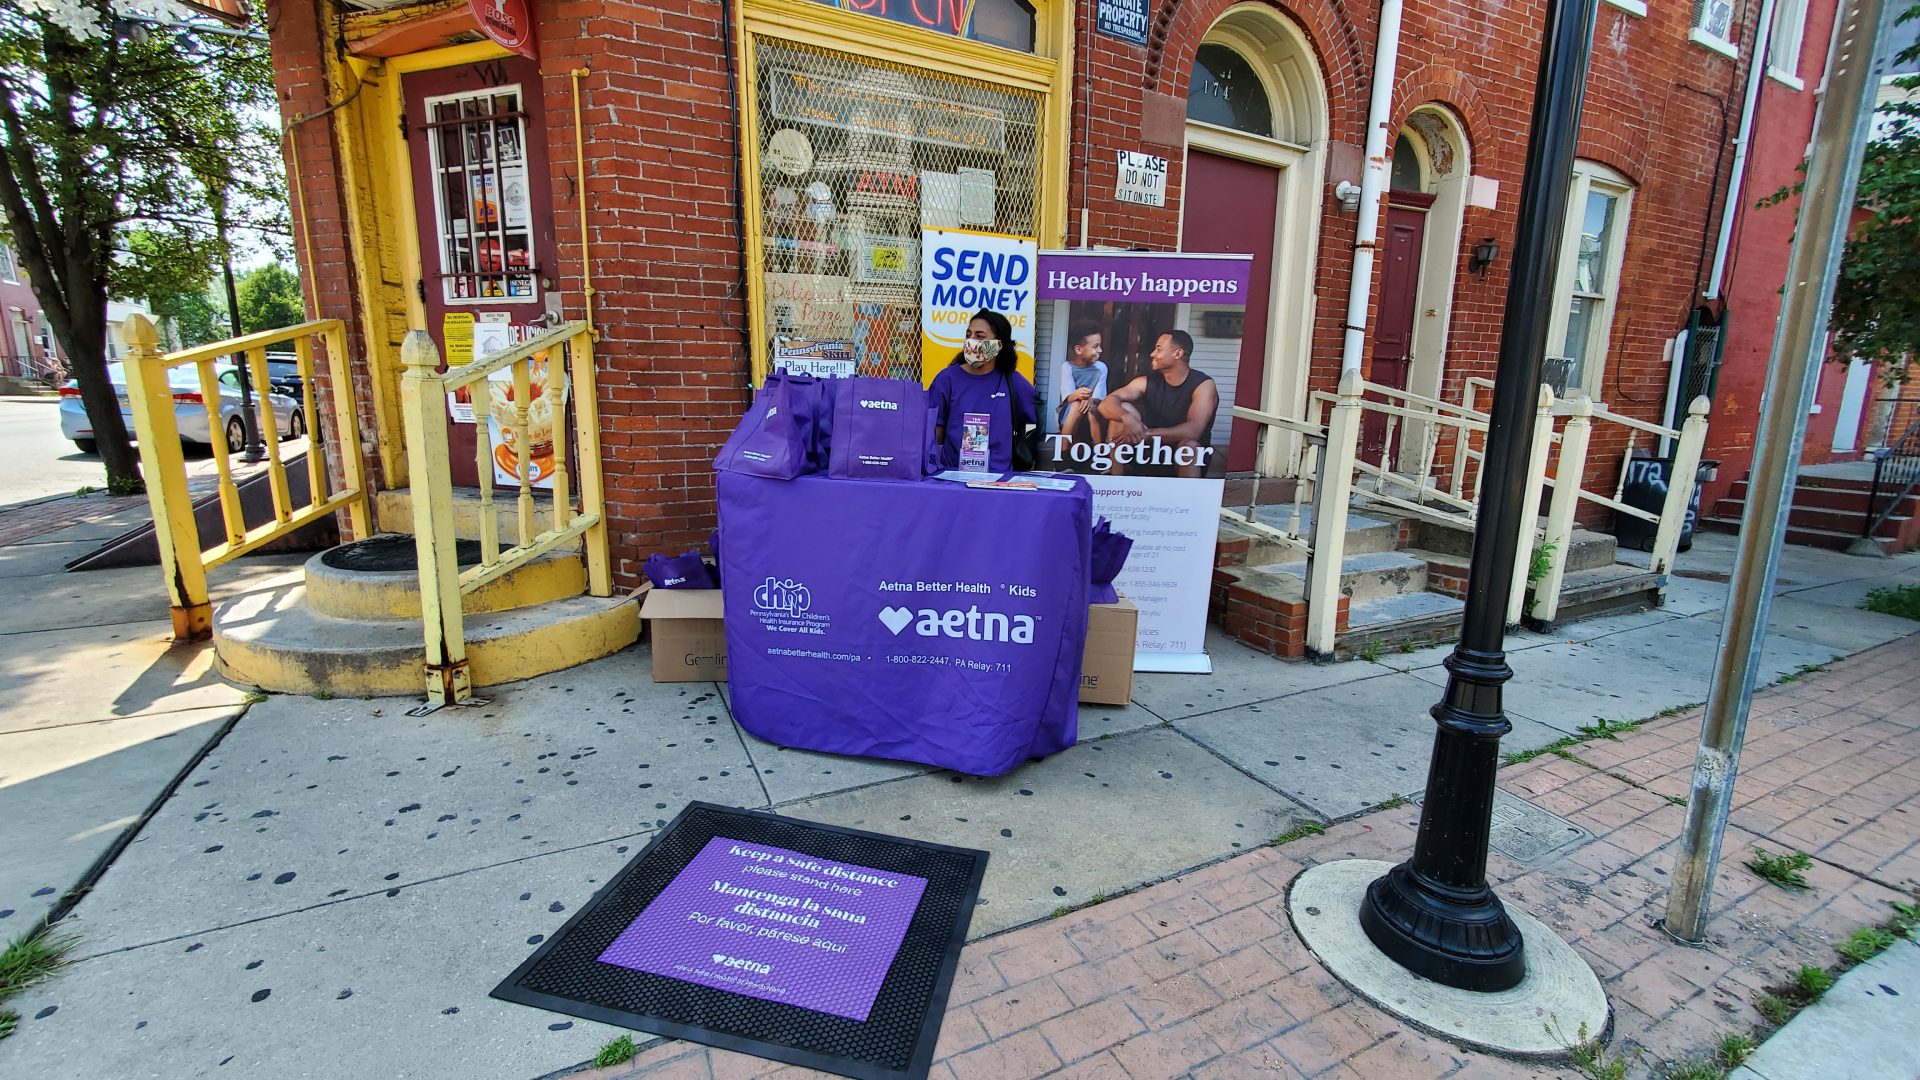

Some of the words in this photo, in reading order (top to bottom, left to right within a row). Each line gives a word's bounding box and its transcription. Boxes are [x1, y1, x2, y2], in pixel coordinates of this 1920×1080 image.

[485, 4, 515, 28] BOSS
[1100, 2, 1147, 31] PROPERTY
[1105, 21, 1111, 30] NO
[1203, 79, 1230, 100] 174
[857, 170, 917, 199] ATM
[1126, 169, 1137, 184] DO
[1141, 172, 1159, 189] NOT
[1118, 189, 1132, 200] SIT
[1134, 191, 1143, 203] ON
[932, 247, 1029, 286] SEND
[1048, 271, 1137, 296] Healthy
[1141, 273, 1238, 297] happens
[932, 284, 1028, 311] MONEY
[931, 309, 1027, 328] WORDE
[780, 341, 843, 356] Pennsylvania
[785, 361, 807, 373] Play
[811, 361, 847, 374] Here!!!
[867, 400, 898, 410] aetna
[1045, 434, 1214, 471] Together
[1092, 488, 1125, 498] support
[1127, 490, 1143, 498] you
[1132, 506, 1147, 515] your
[1149, 506, 1174, 515] Primary
[879, 580, 913, 592] Aetna
[916, 581, 952, 593] Better
[955, 582, 991, 595] Health
[1009, 585, 1037, 598] Kids
[750, 609, 790, 619] Pennsylvania's
[801, 612, 831, 622] Children's
[778, 618, 805, 627] Insurance
[806, 621, 831, 629] Program
[915, 605, 1035, 644] aetna
[778, 625, 798, 634] Cover
[798, 626, 808, 634] All
[809, 627, 826, 635] Kids.
[1142, 641, 1167, 651] Relay:
[767, 647, 861, 663] aetnabetterhealth.com/pa
[955, 659, 966, 668] PA
[967, 660, 994, 672] Relay:
[996, 662, 1012, 672] 711
[729, 845, 771, 862] Keep
[771, 854, 785, 864] a
[787, 856, 822, 873] safe
[823, 865, 899, 889] distance
[742, 864, 788, 879] please
[789, 873, 829, 889] stand
[831, 882, 863, 897] here
[708, 879, 800, 908] Mantenga
[801, 896, 821, 912] la
[687, 911, 715, 926] Por
[715, 916, 754, 935] favor,
[723, 955, 772, 976] aetna
